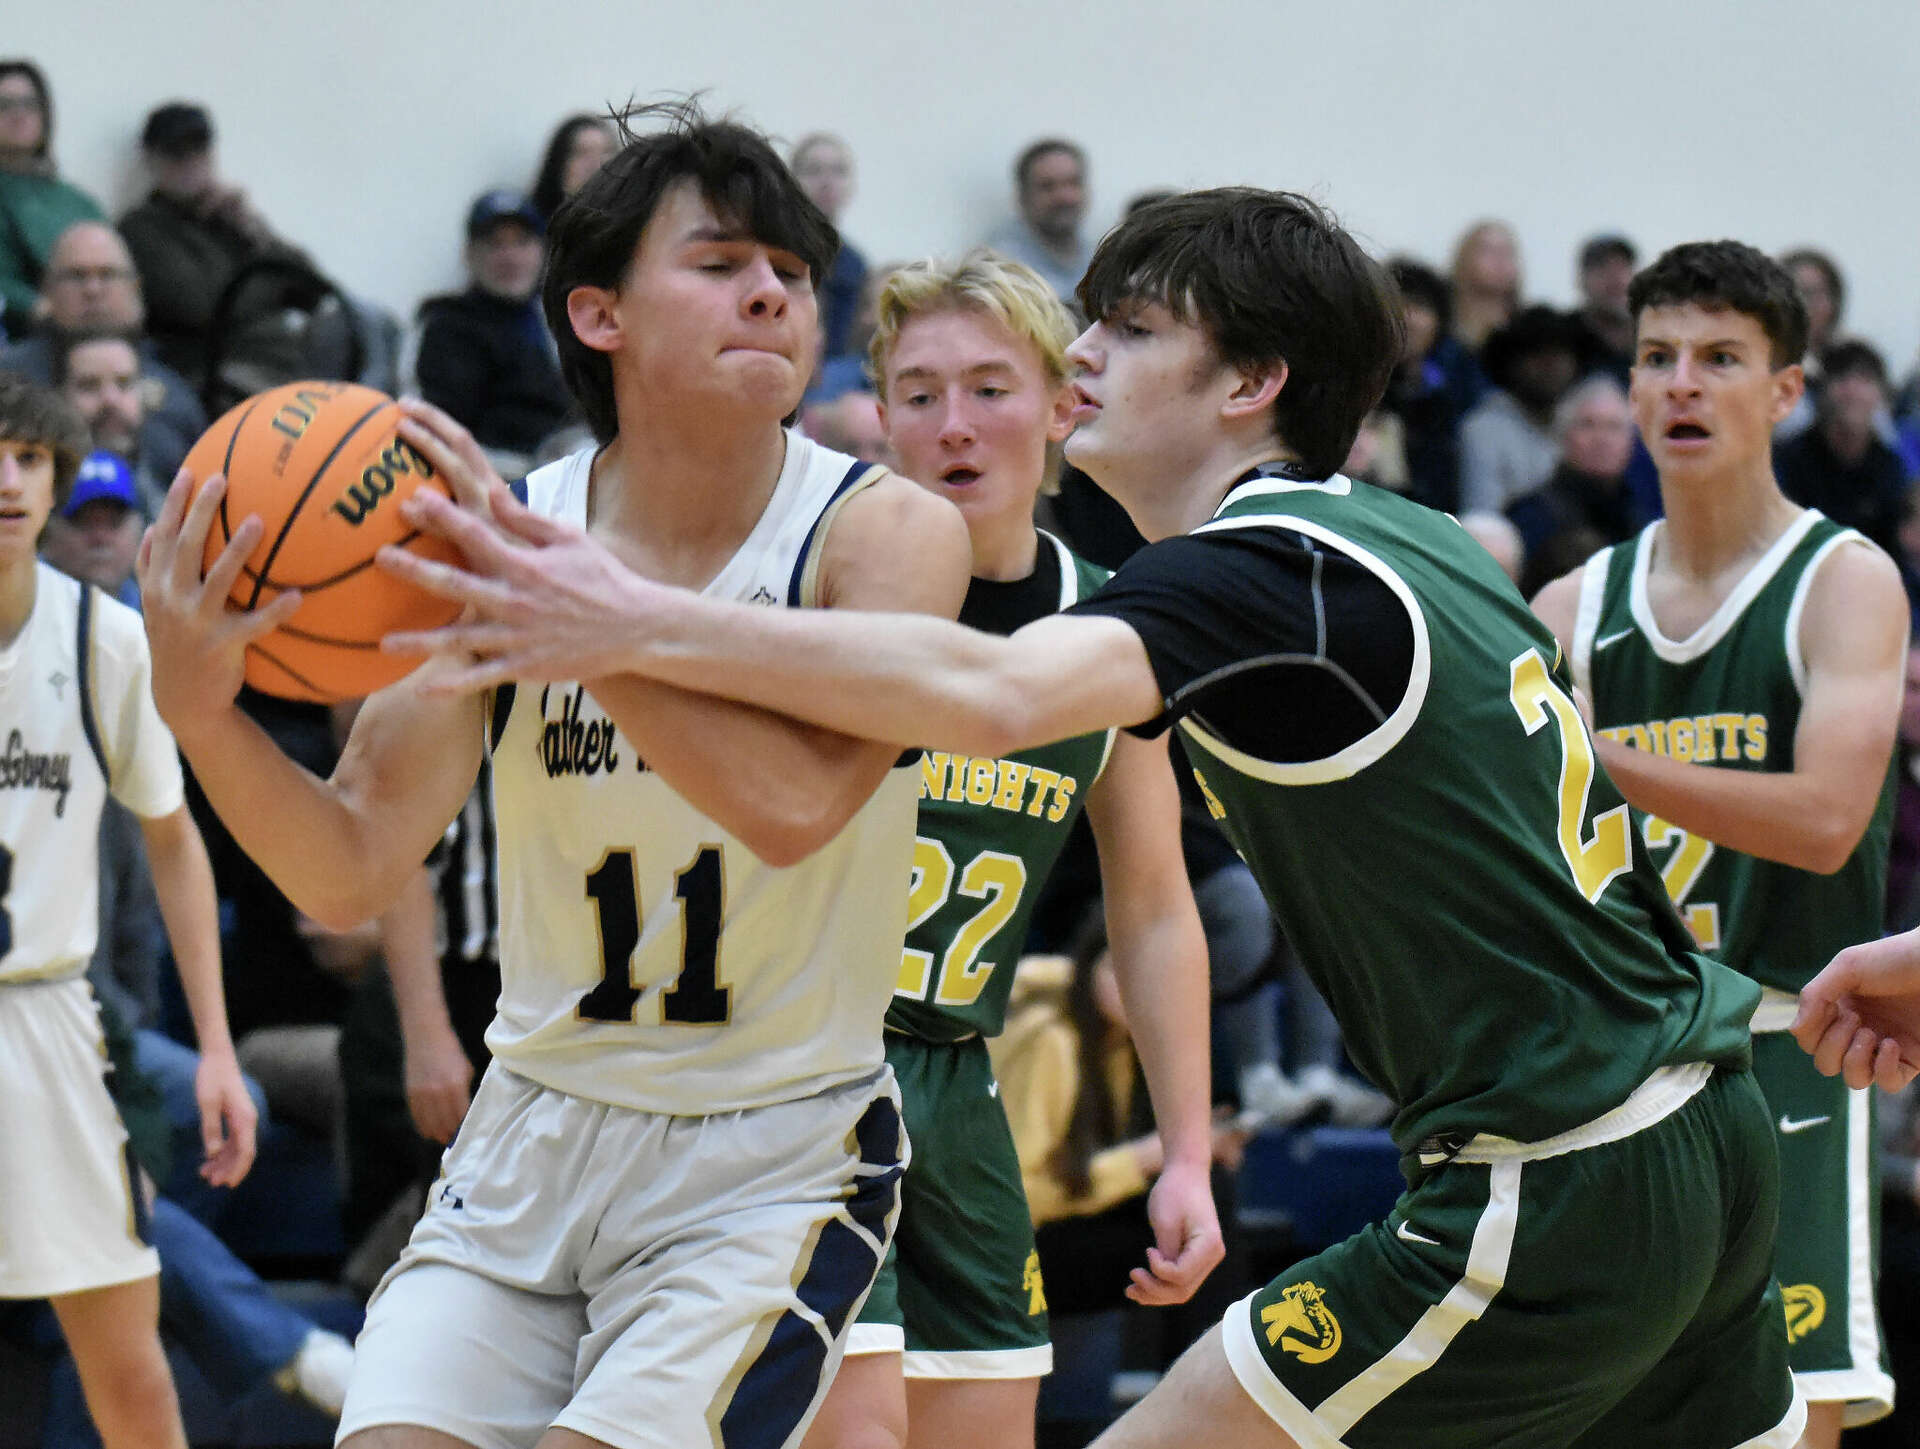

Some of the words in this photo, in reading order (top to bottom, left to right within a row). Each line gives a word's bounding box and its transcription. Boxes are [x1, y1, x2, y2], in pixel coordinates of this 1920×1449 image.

[333, 435, 434, 526] lson
[537, 681, 619, 779] ather
[919, 750, 1077, 823] NIGHTS
[574, 842, 734, 1027] 11
[893, 836, 1027, 1006] 22
